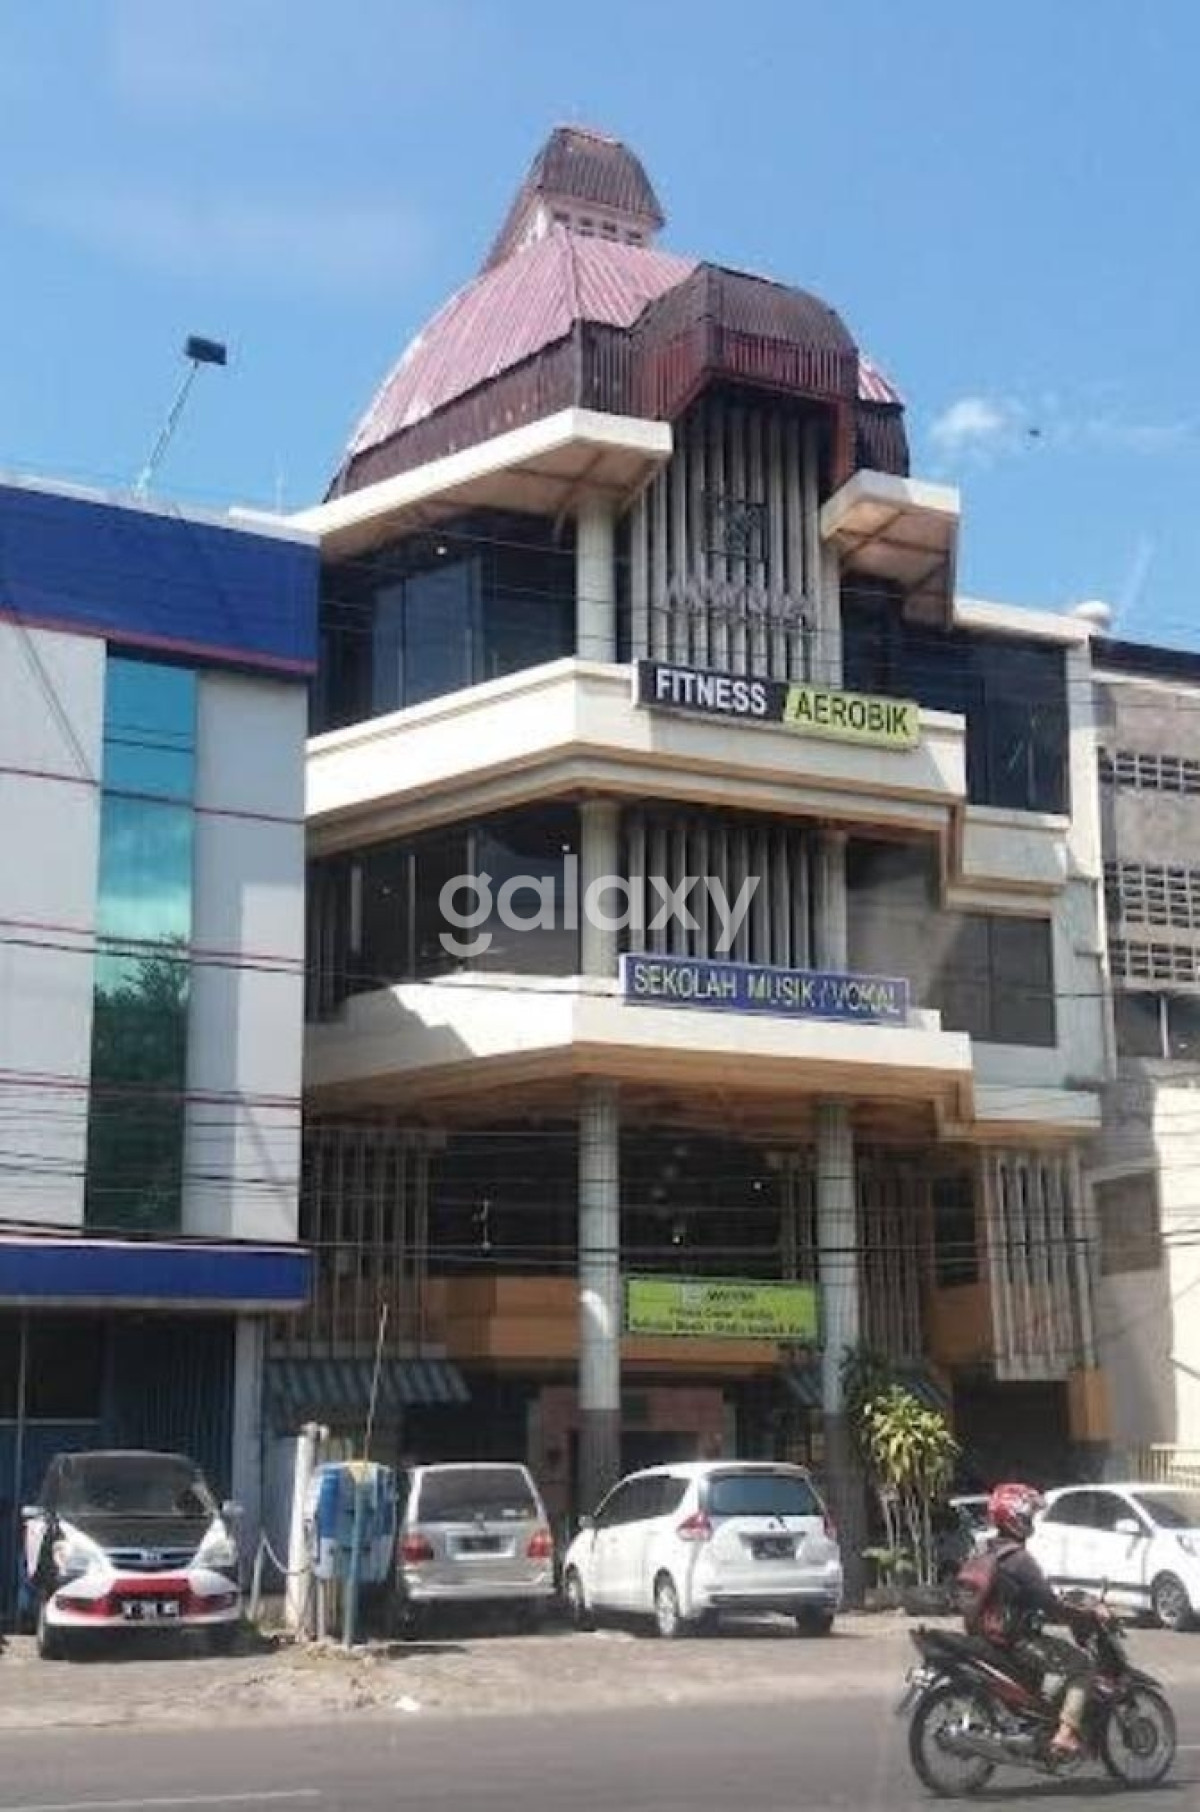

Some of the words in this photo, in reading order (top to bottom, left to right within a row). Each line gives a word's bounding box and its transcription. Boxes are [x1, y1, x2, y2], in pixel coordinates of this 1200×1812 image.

[656, 668, 767, 715] FITNESS
[795, 690, 911, 737] AEROBIK
[633, 963, 737, 1000] SEKOLAH
[747, 973, 816, 1009] MUSIK
